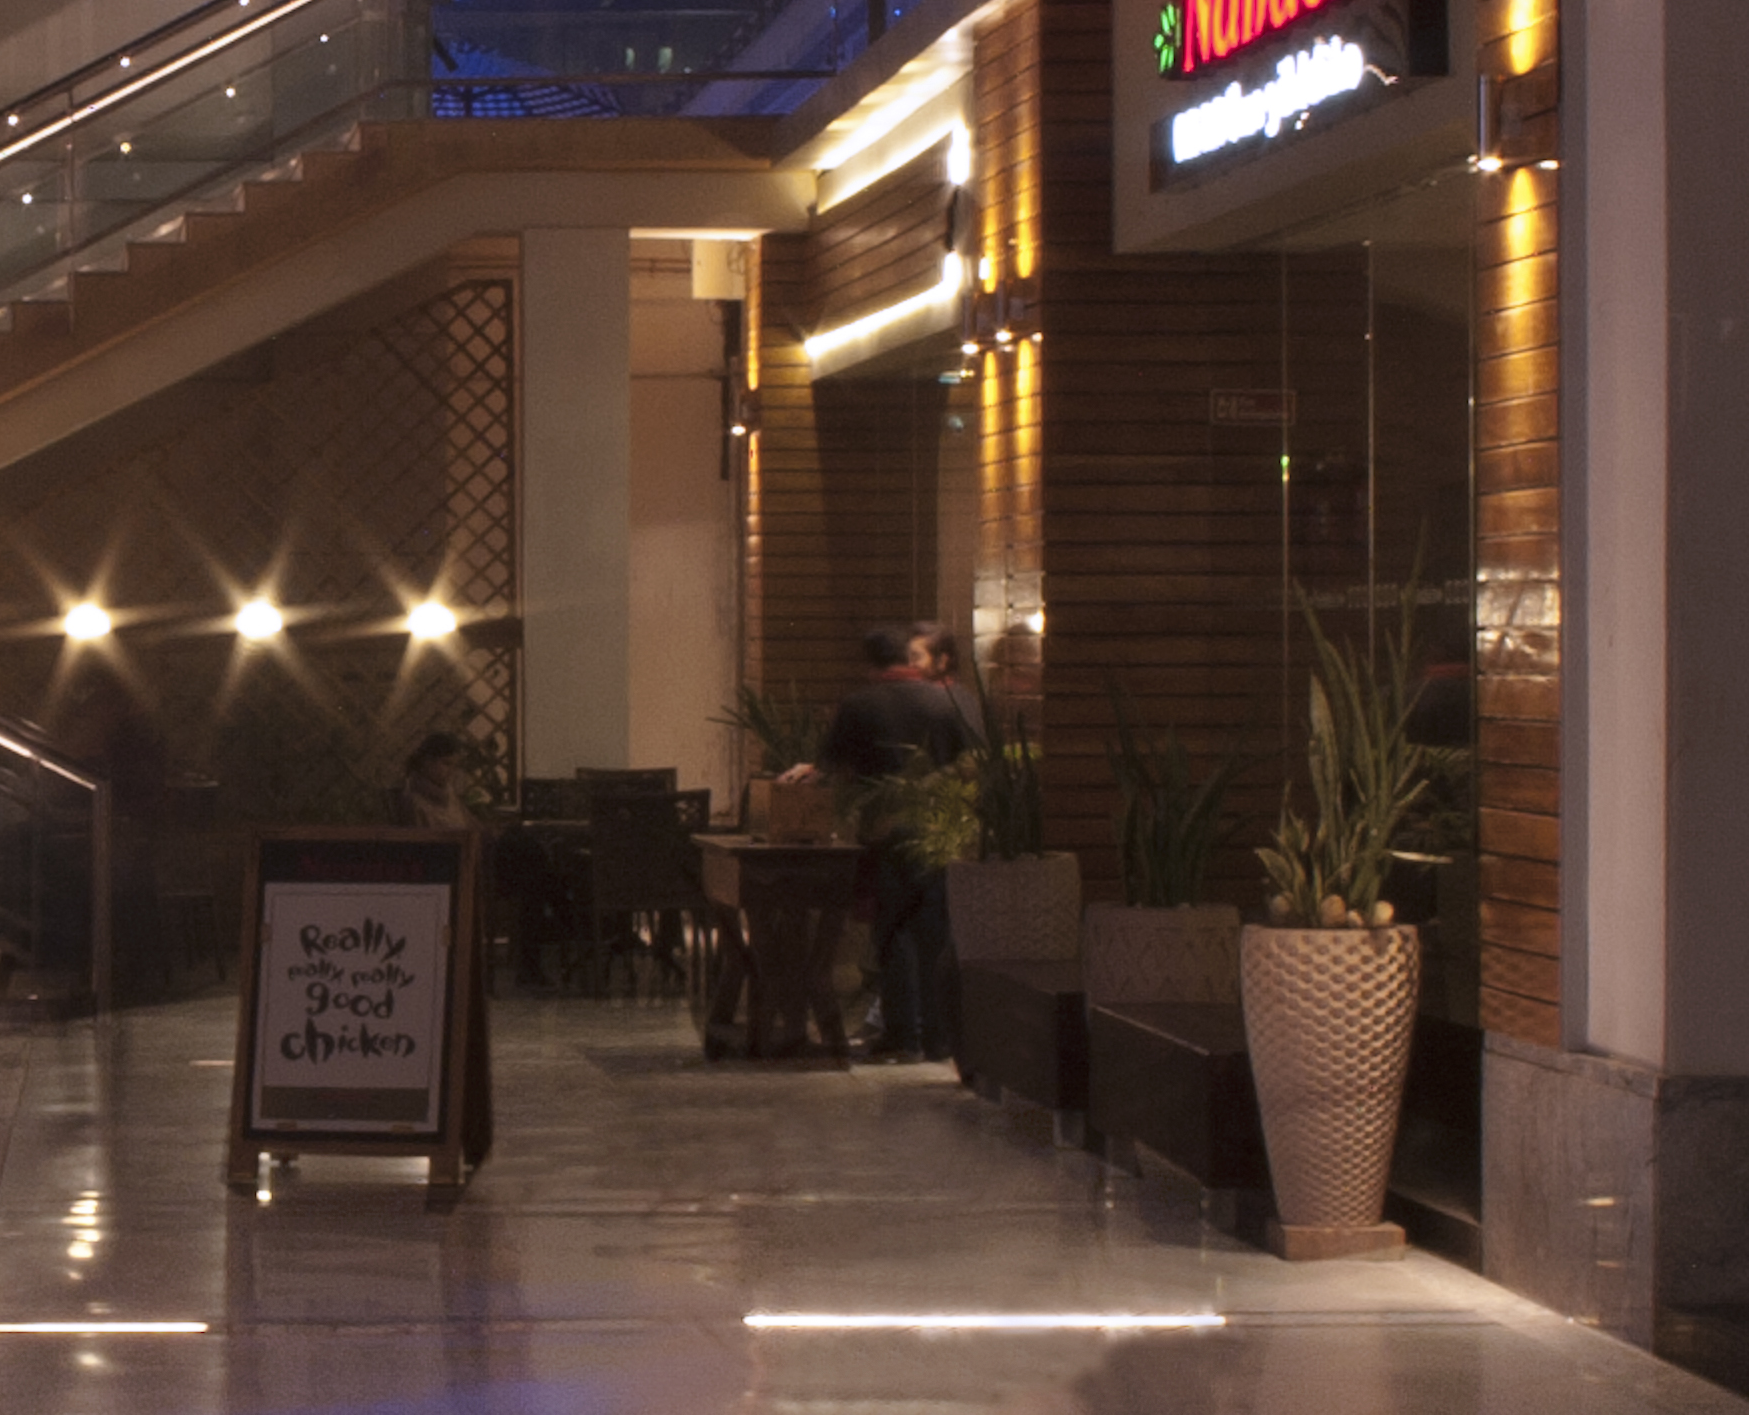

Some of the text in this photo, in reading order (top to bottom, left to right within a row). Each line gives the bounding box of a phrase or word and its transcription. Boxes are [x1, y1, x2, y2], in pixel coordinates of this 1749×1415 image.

[300, 917, 406, 963] Really
[351, 963, 415, 989] really
[305, 981, 394, 1019] good
[280, 1017, 416, 1064] chicken
